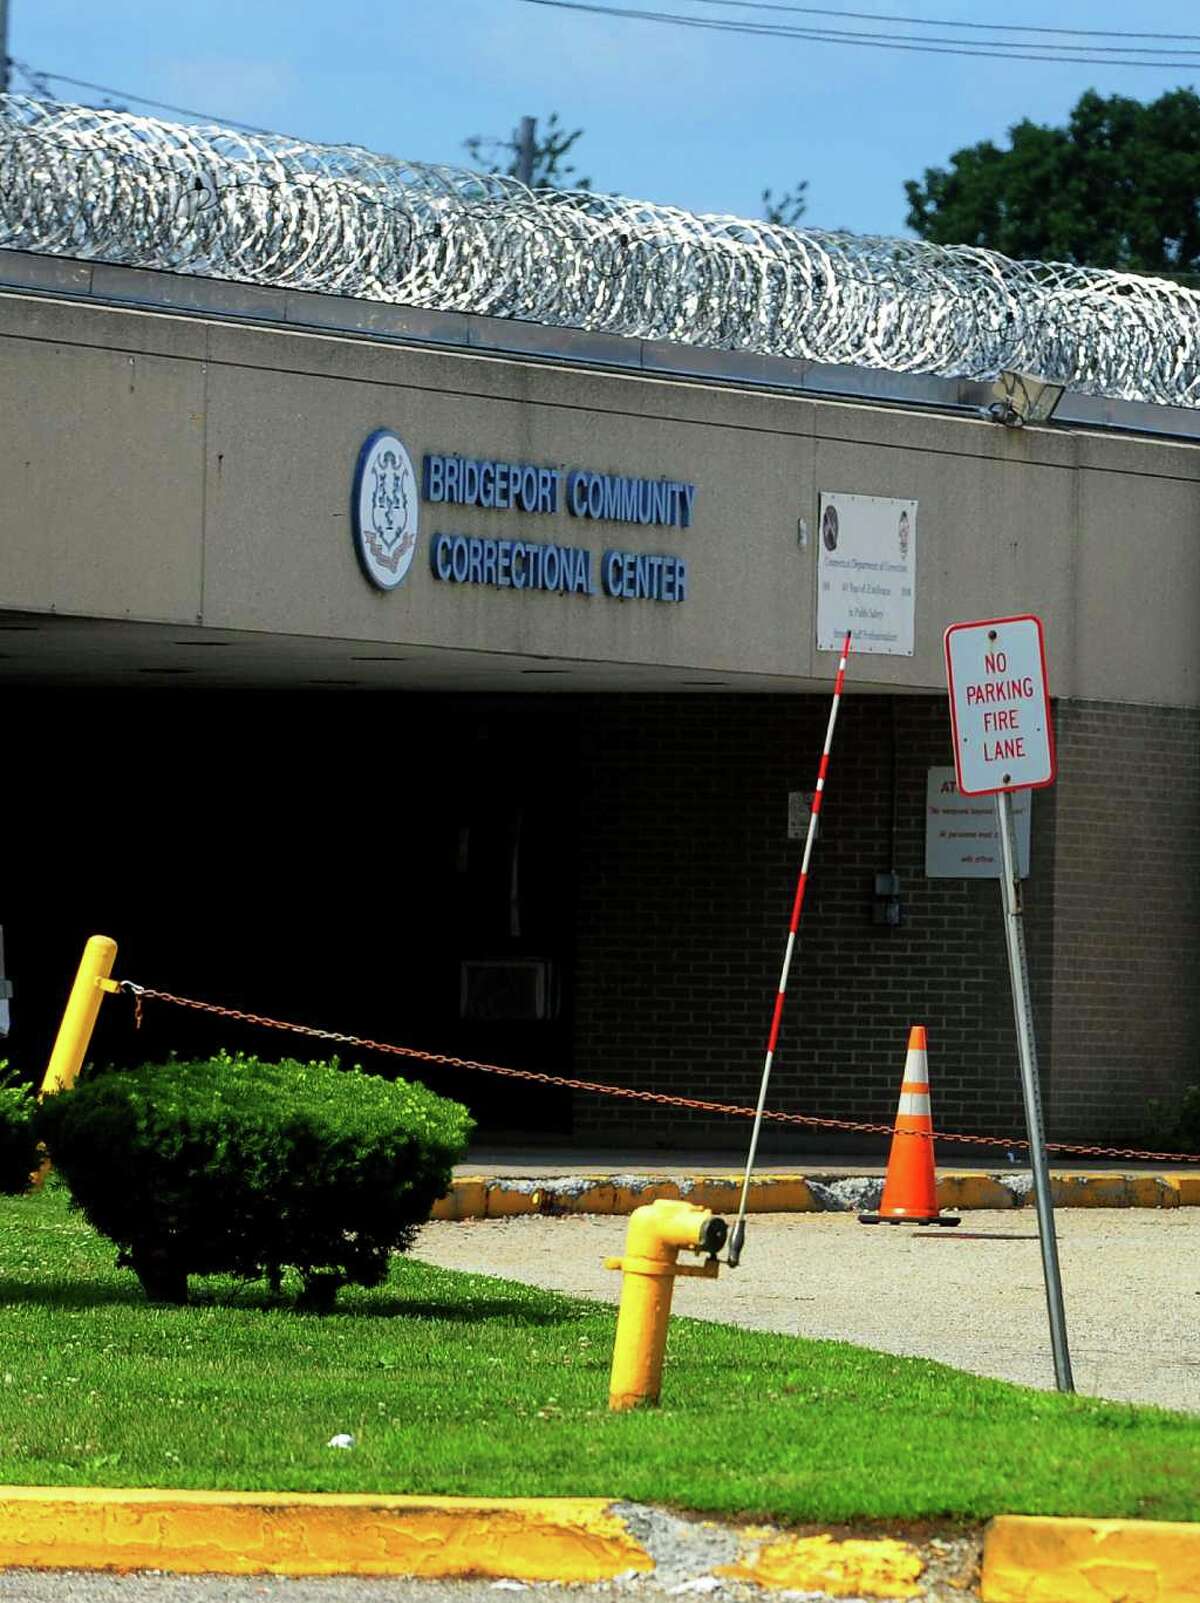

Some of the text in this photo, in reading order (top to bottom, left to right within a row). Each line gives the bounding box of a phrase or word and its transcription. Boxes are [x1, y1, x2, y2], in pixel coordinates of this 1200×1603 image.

[423, 455, 697, 528] BRIDGEPORT COMMUNITY
[430, 532, 597, 597] CORRECTIONAL
[602, 550, 689, 602] CENTER
[984, 652, 1008, 675] NO
[966, 677, 1034, 706] PARKING
[984, 709, 1019, 733] FIRE
[984, 737, 1026, 762] LANE
